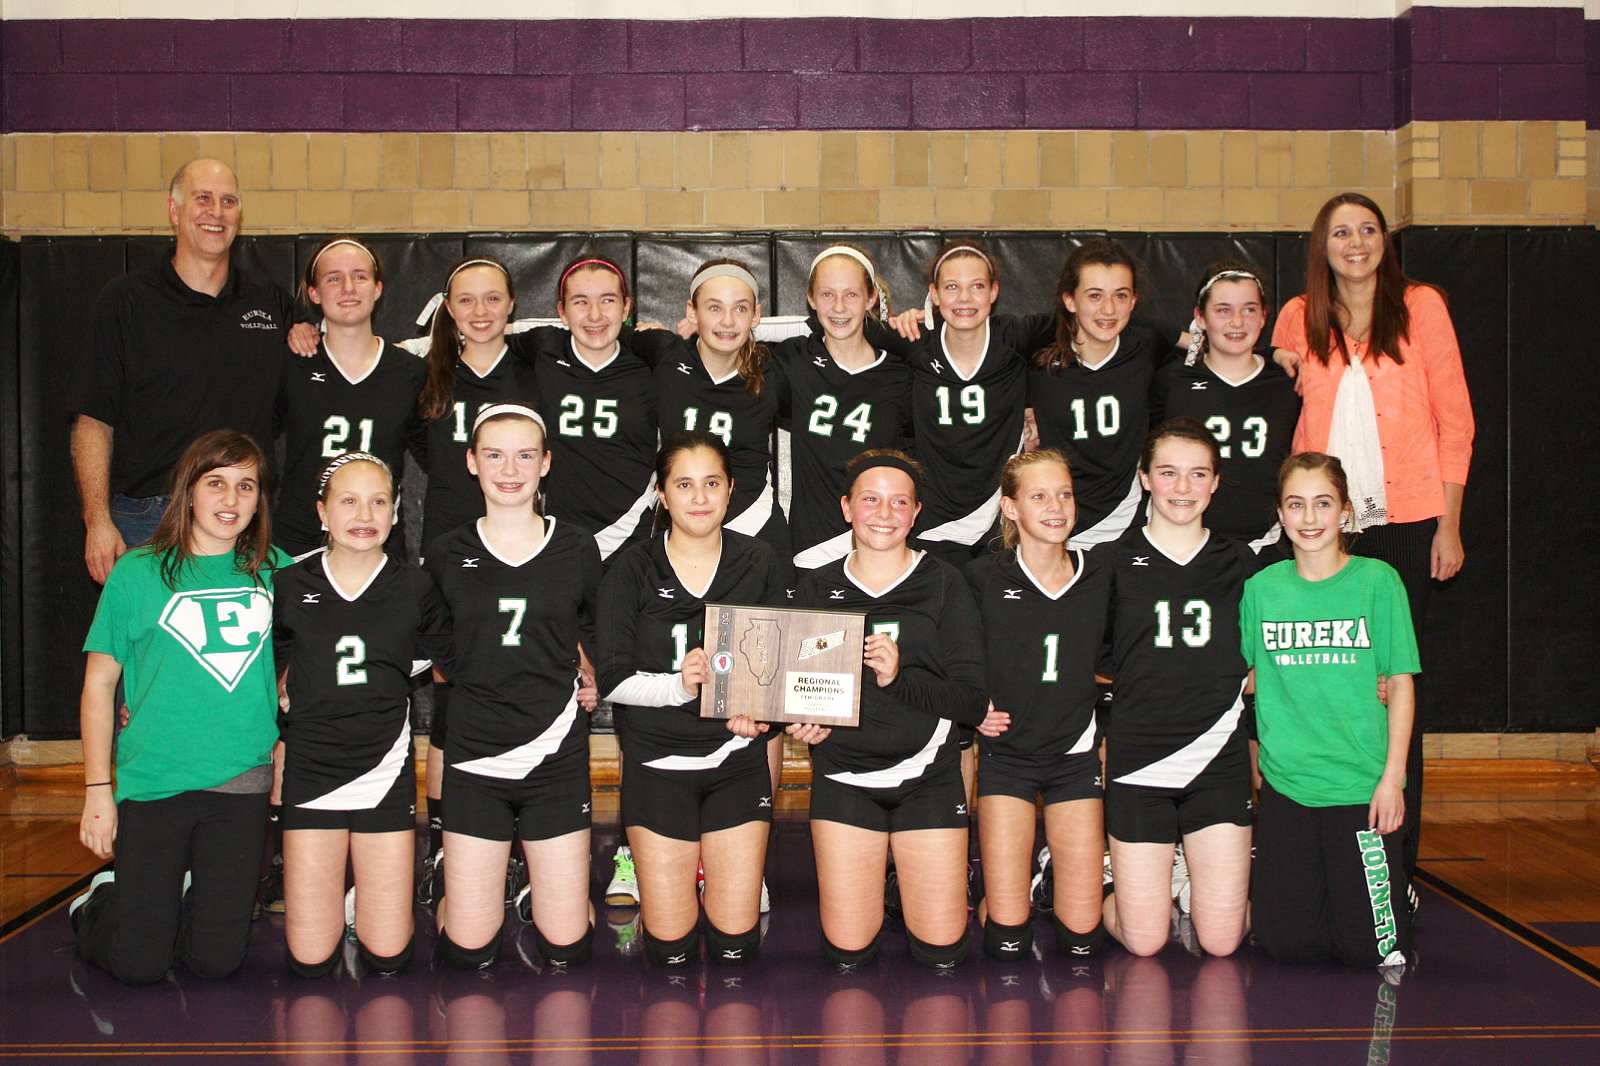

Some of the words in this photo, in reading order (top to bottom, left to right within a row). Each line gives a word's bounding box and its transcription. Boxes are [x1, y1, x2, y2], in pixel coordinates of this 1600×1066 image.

[241, 309, 272, 321] EUREKA
[559, 393, 618, 439] 25
[808, 394, 872, 443] 24
[935, 384, 986, 426] 19
[1070, 395, 1120, 440] 10
[321, 414, 374, 457] 21
[1204, 415, 1268, 458] 23
[191, 592, 261, 656] E
[498, 597, 528, 647] 7
[1154, 599, 1212, 648] 13
[1261, 615, 1372, 652] EUREKA
[335, 635, 368, 686] 2
[1042, 633, 1060, 682] 1
[1275, 652, 1357, 666] VOLLEYBALL
[793, 685, 845, 695] CHAMPIONS
[797, 676, 841, 686] REGIONAL
[1356, 829, 1397, 958] HORNETS
